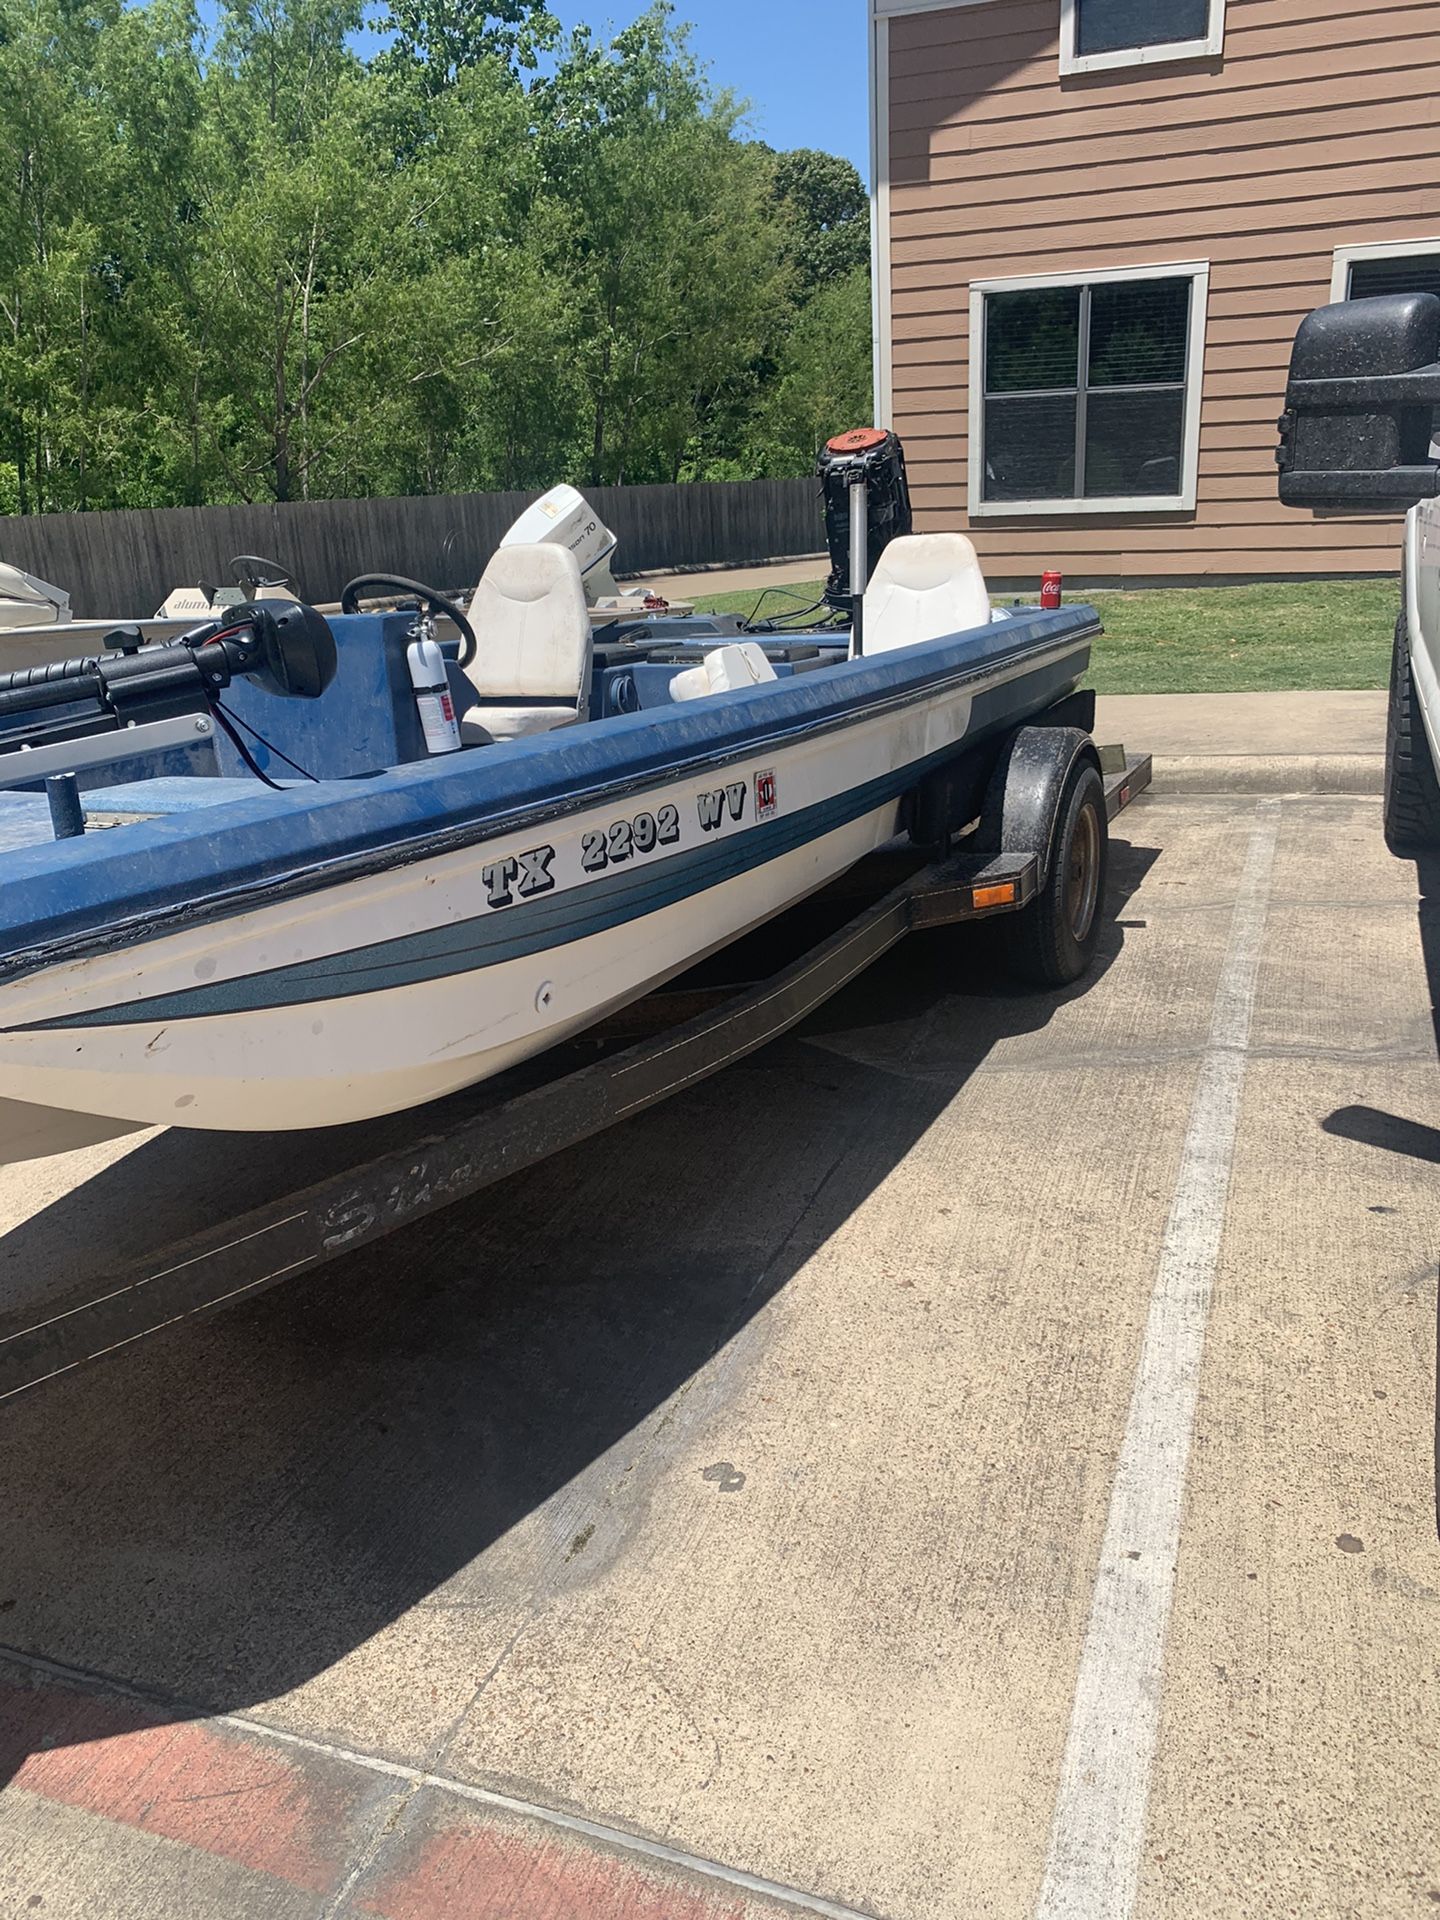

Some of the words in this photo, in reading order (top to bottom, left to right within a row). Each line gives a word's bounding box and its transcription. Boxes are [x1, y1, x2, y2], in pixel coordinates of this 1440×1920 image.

[584, 521, 597, 536] 70
[482, 845, 555, 909] TX
[581, 804, 679, 873] 2292
[697, 781, 746, 831] WV
